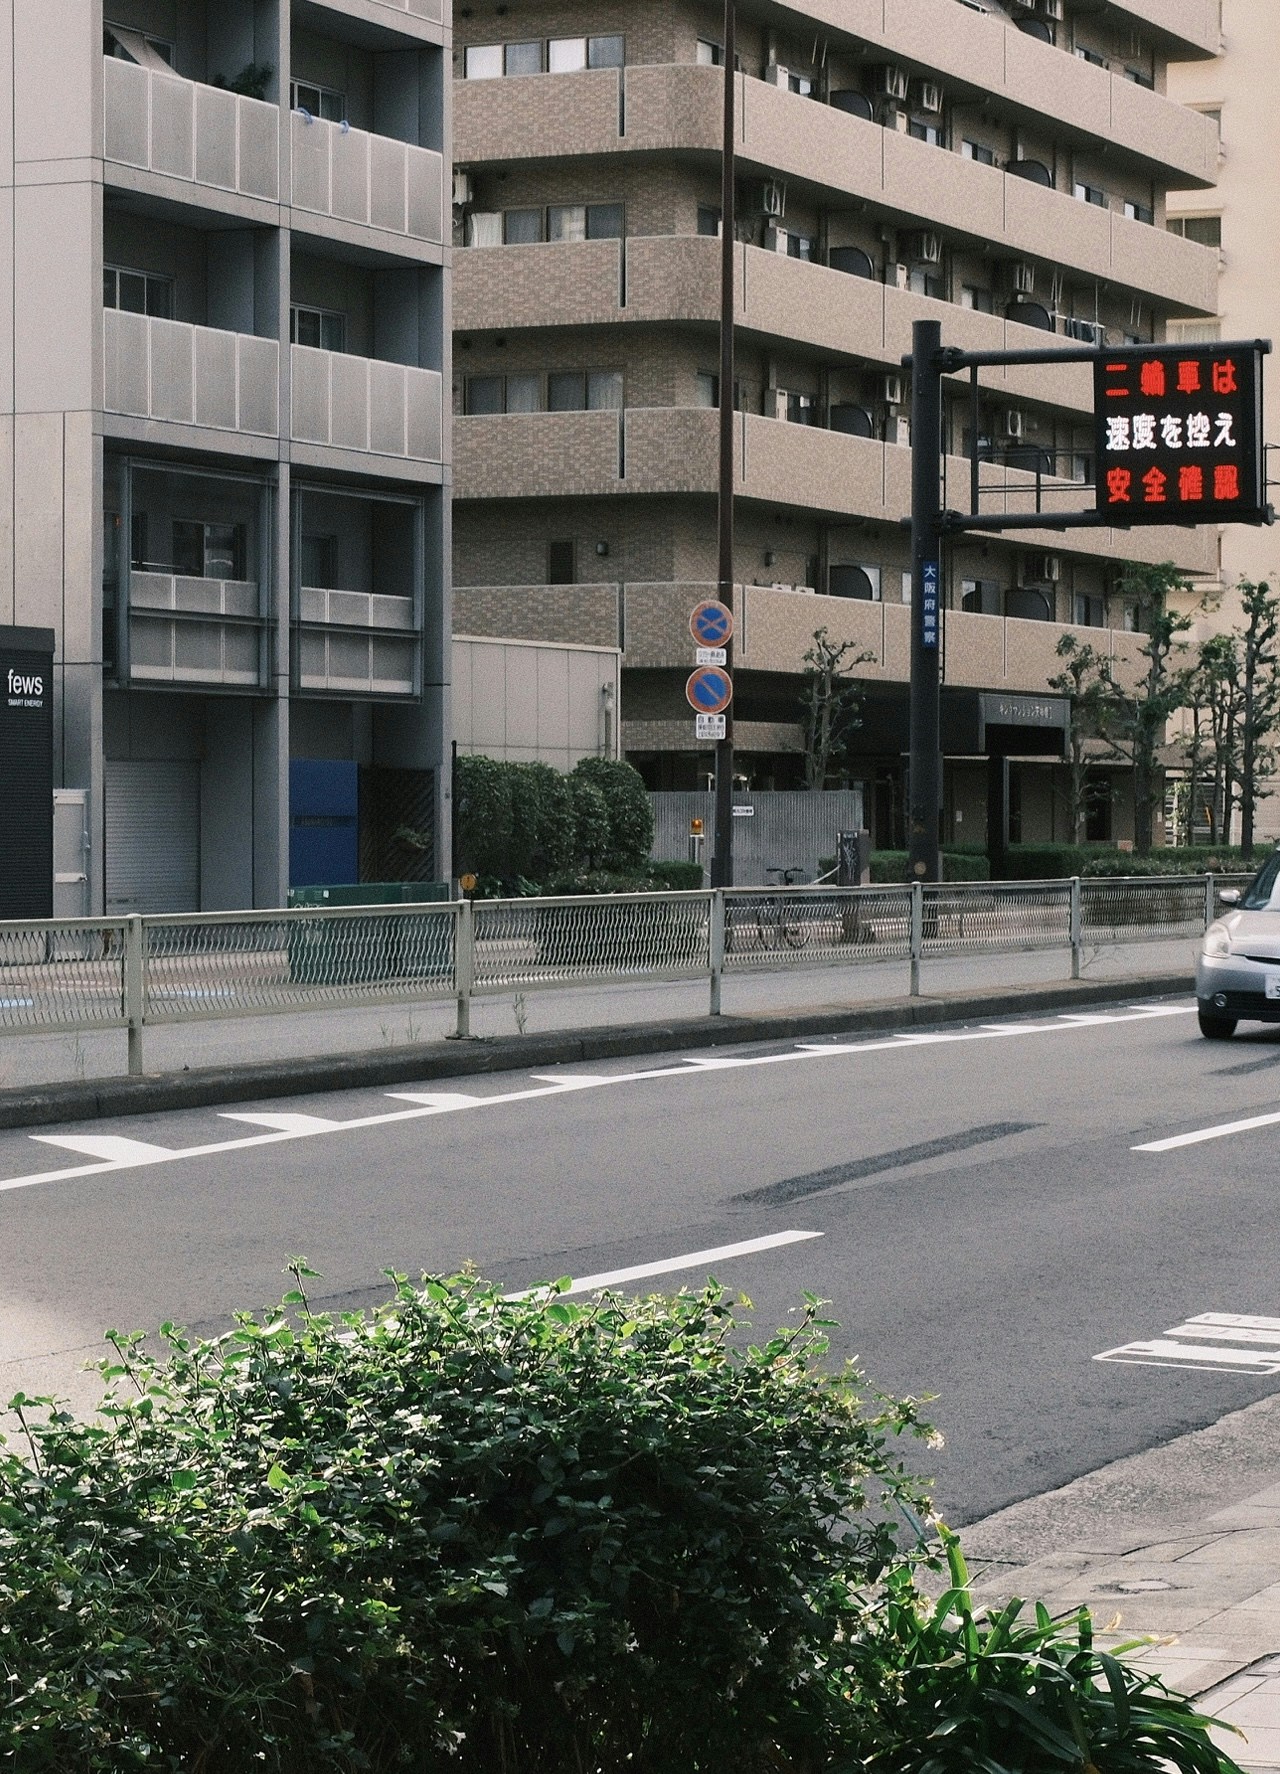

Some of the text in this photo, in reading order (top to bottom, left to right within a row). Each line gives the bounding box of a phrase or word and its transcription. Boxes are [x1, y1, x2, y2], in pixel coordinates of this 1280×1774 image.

[1106, 360, 1237, 397] 二輪車は
[1106, 411, 1236, 450] 速度を控え
[1106, 465, 1239, 502] 安全確認
[923, 565, 936, 644] 大阪府警察
[8, 669, 43, 696] fews
